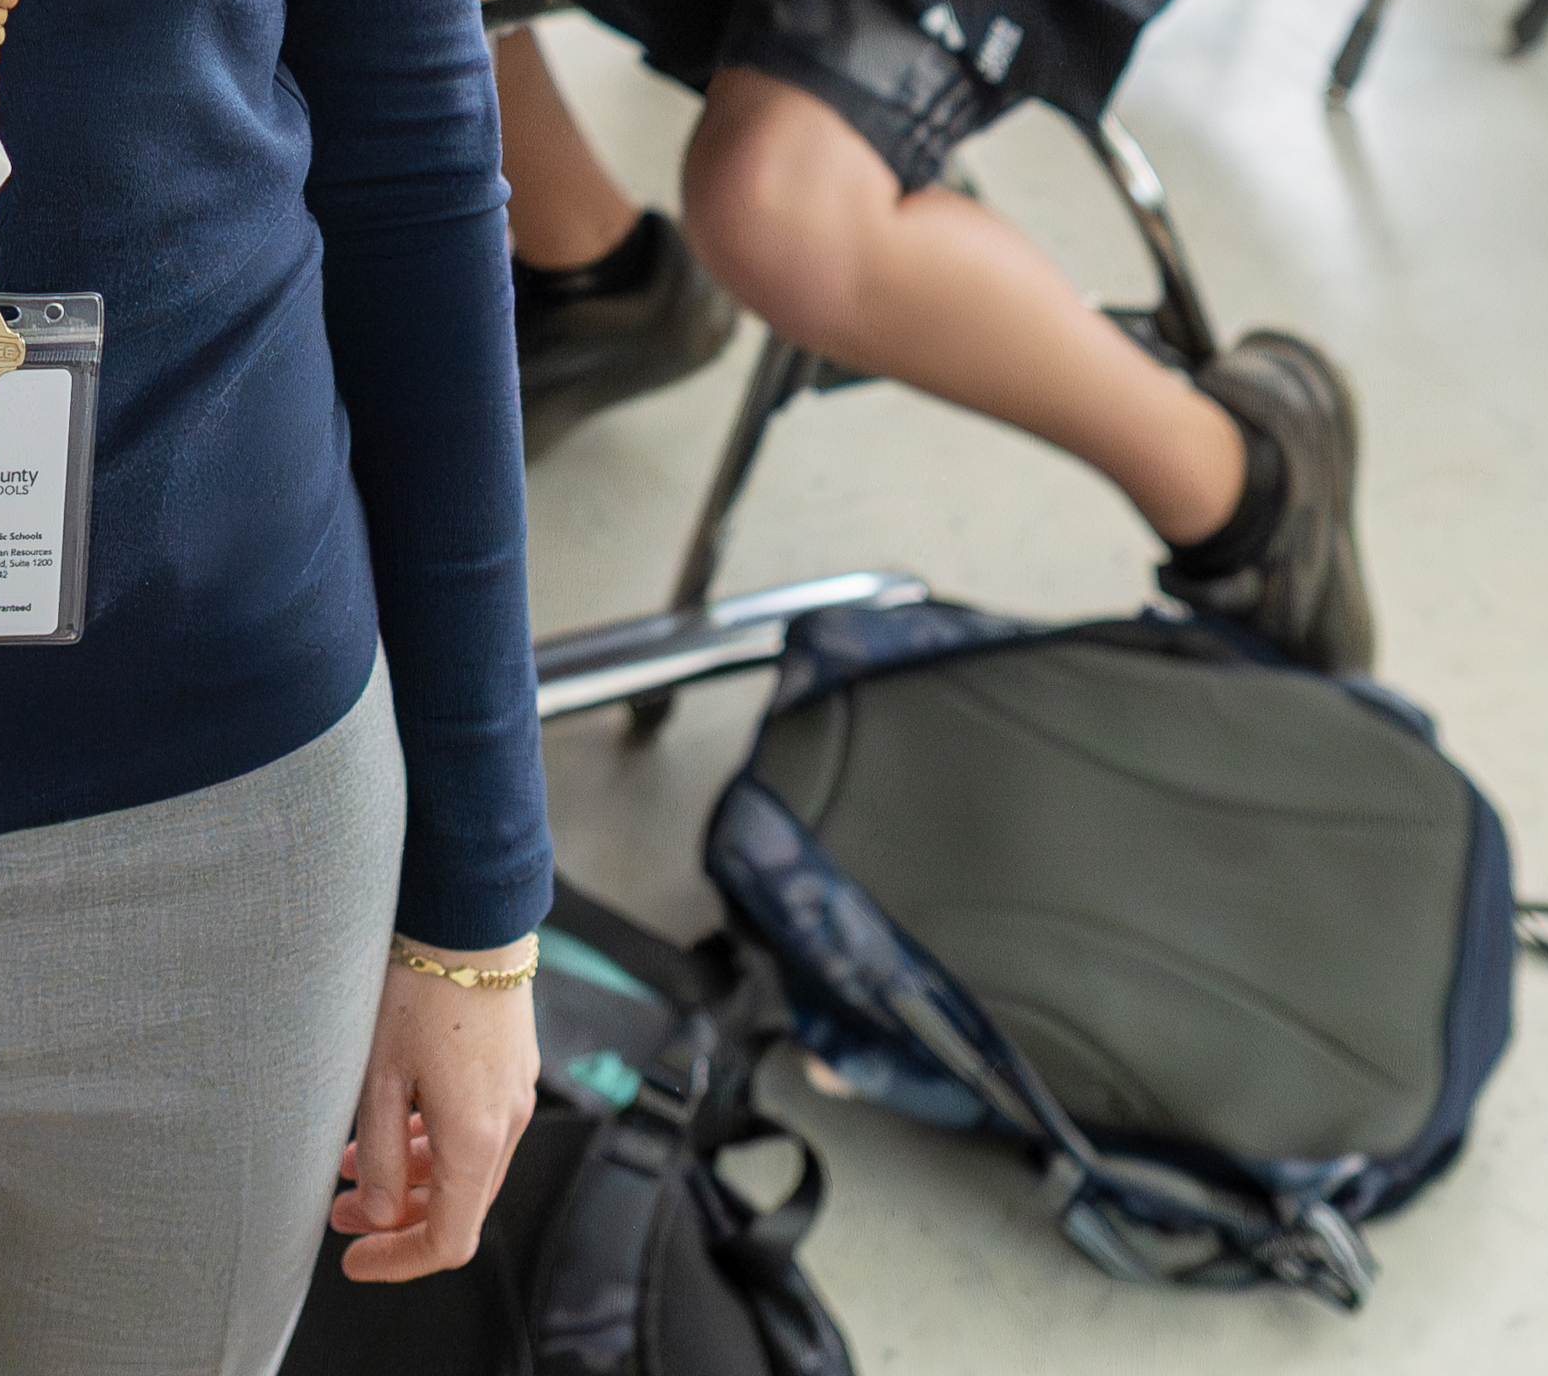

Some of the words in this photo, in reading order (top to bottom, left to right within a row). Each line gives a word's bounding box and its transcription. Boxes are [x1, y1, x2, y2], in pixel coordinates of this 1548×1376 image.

[9, 531, 43, 540] Schools
[10, 548, 53, 557] Resources
[9, 559, 30, 568] Suite
[32, 558, 53, 567] 1200
